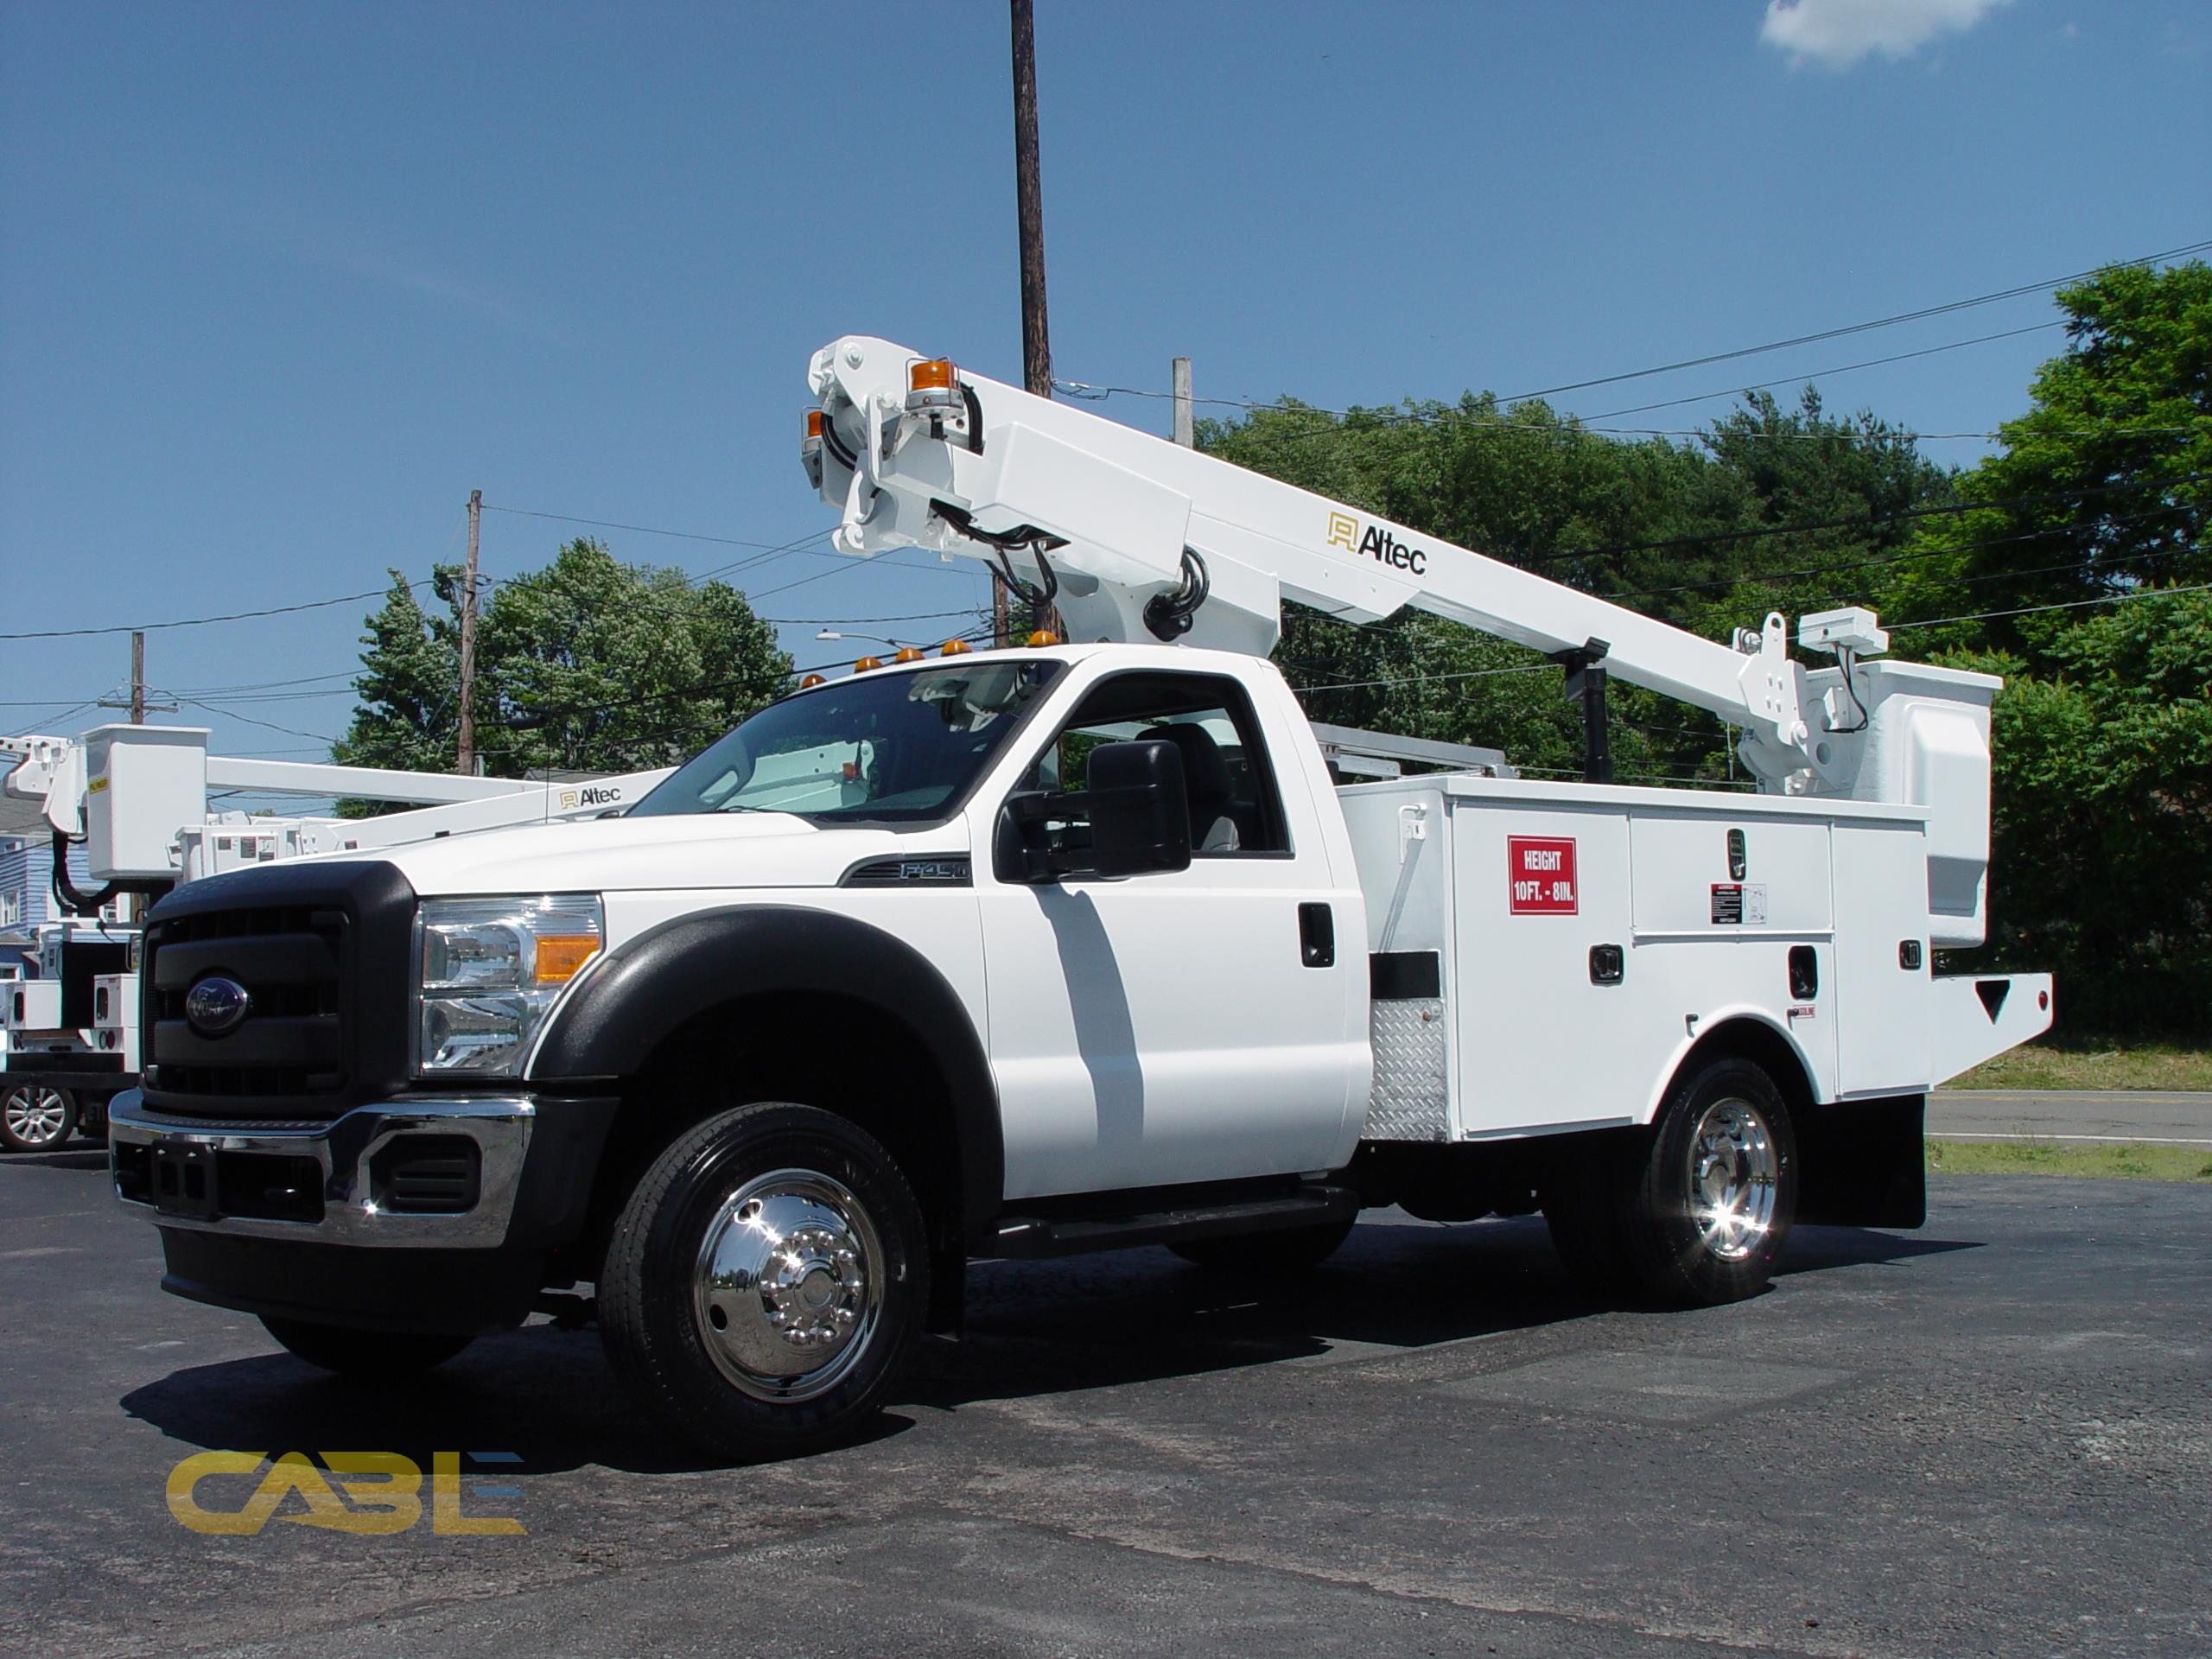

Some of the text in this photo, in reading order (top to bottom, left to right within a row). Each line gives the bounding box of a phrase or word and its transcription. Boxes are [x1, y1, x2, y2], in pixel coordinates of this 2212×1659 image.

[1357, 525, 1427, 575] Altec
[581, 787, 621, 806] Altec
[1523, 850, 1561, 871] HEIGHT
[1514, 880, 1542, 901] 10FT.
